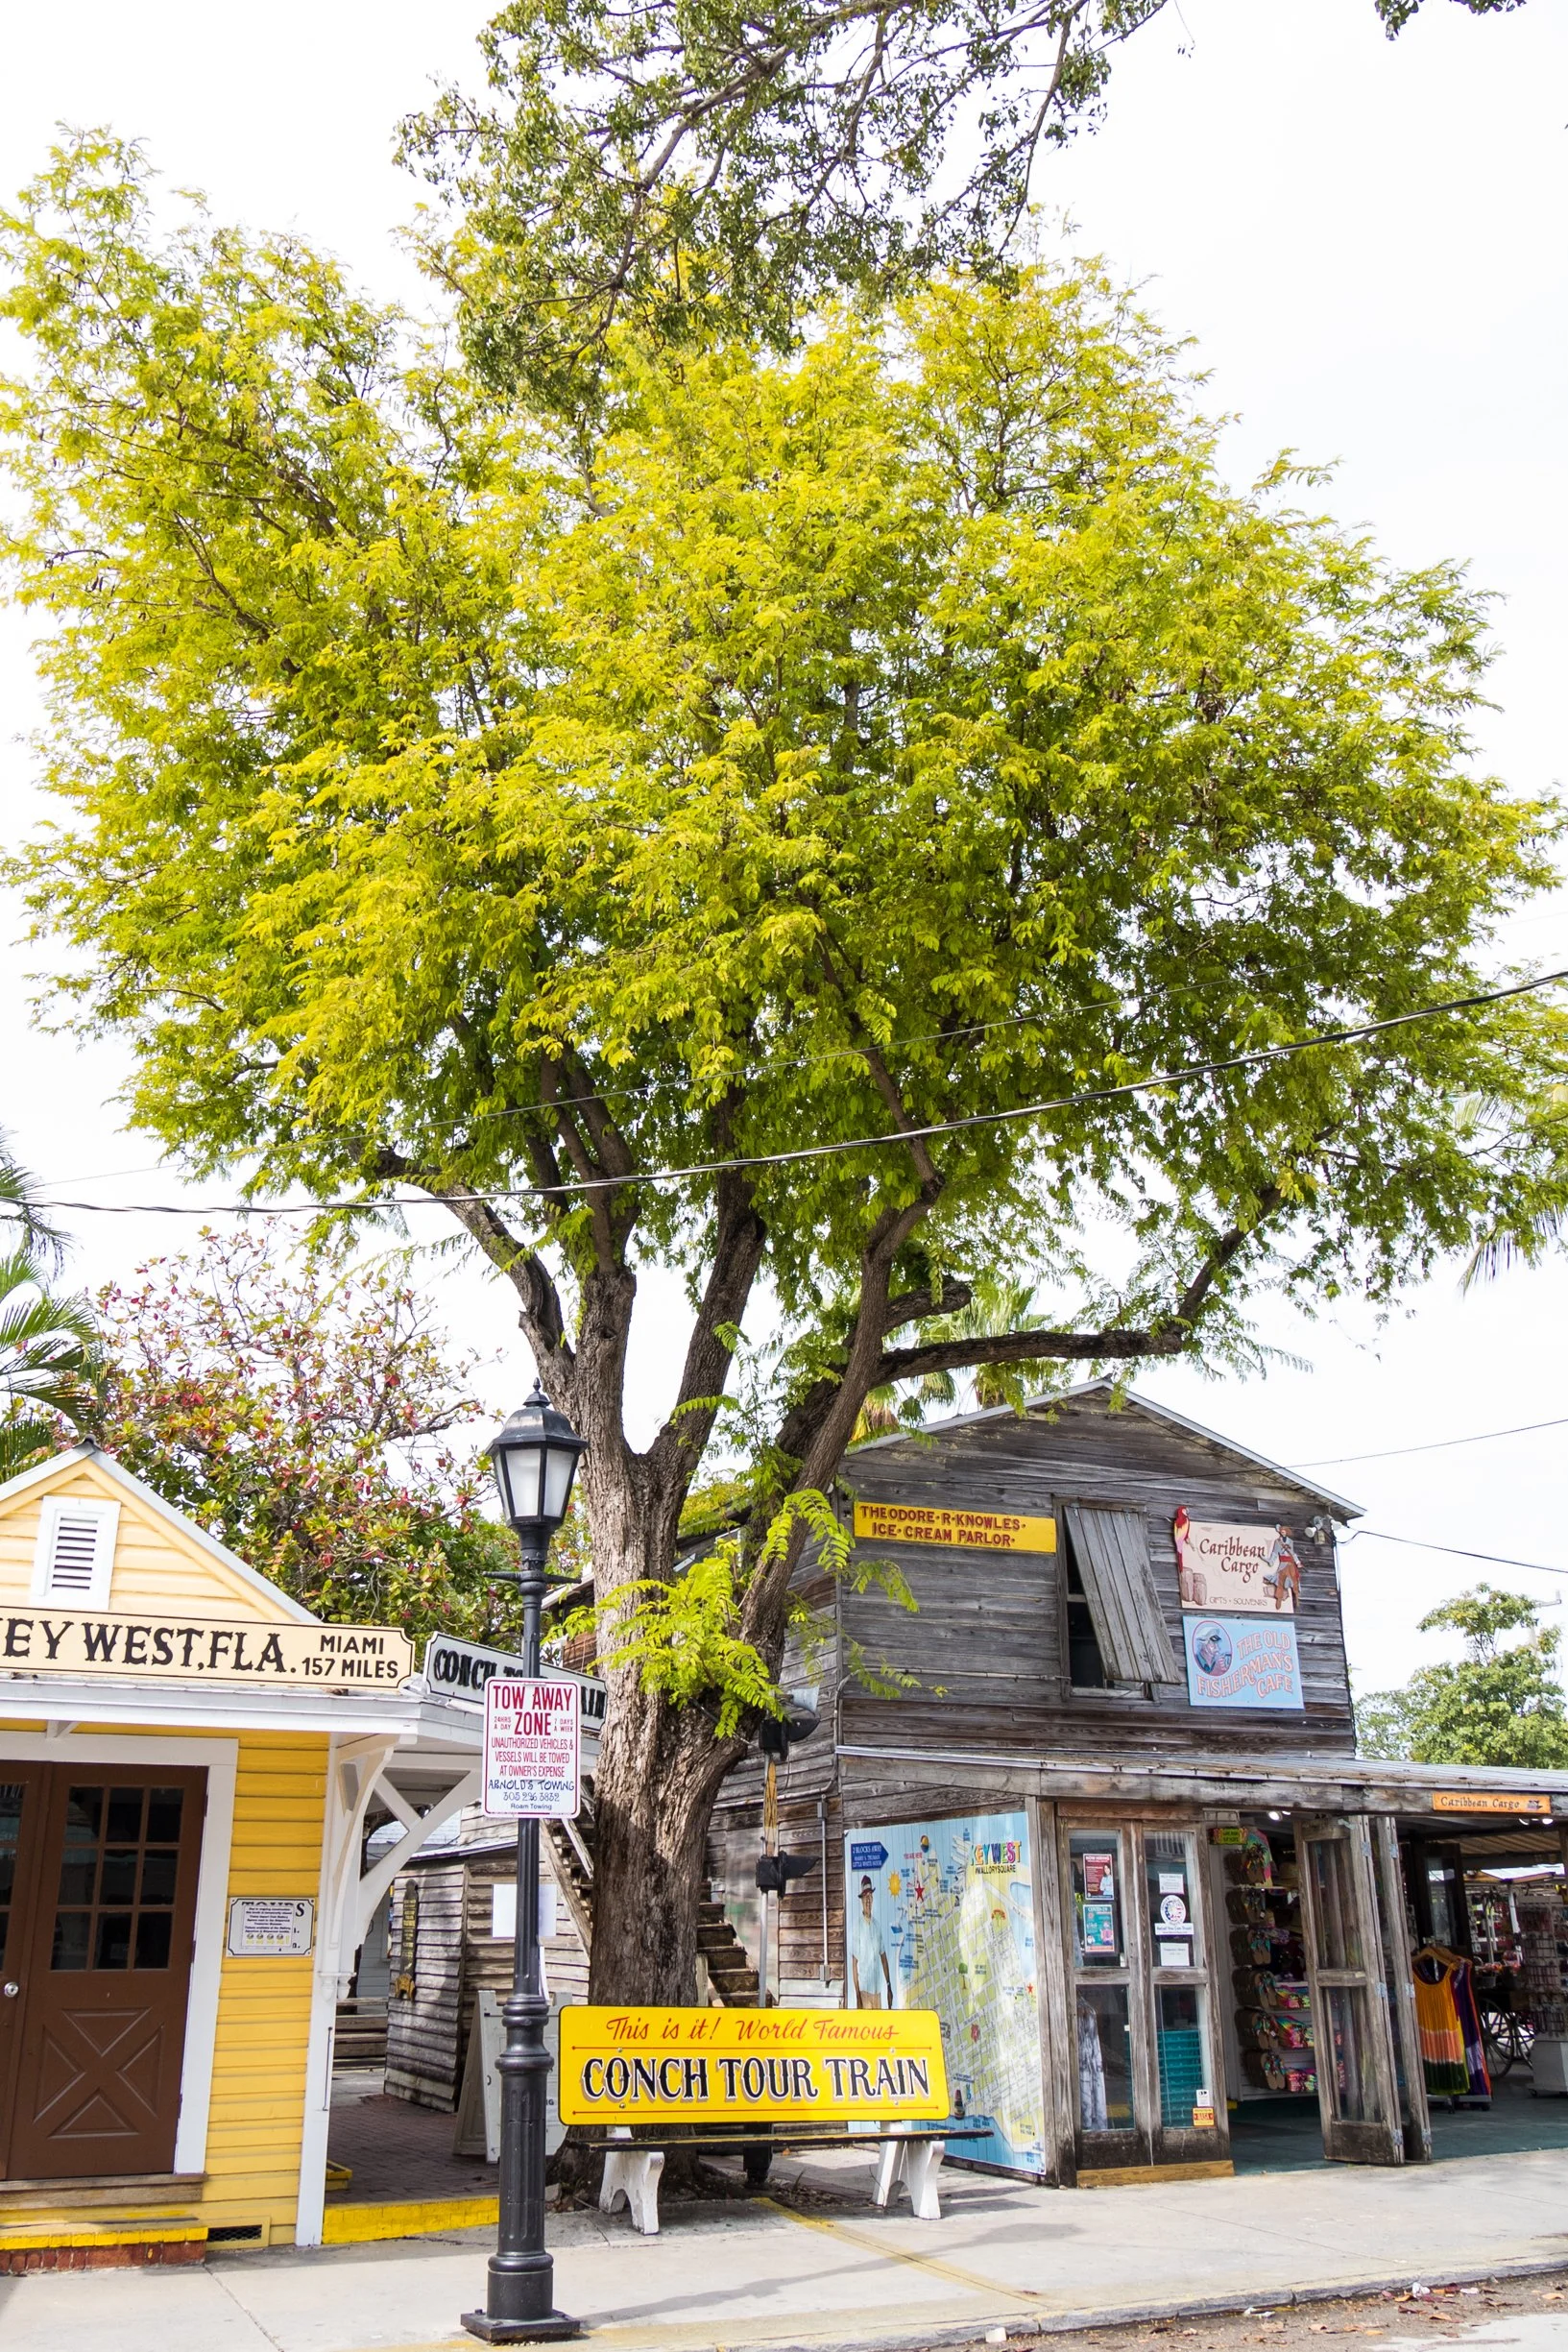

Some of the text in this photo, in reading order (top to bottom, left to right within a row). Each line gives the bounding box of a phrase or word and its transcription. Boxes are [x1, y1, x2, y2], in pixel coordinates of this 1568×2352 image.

[1199, 1537, 1266, 1559] Caribbean
[1220, 1556, 1259, 1584] Cargo
[1209, 1596, 1227, 1605] GIFTS
[0, 1617, 74, 1660] EY
[320, 1634, 383, 1655] MIAMI
[1237, 1629, 1291, 1660] THE OLD
[302, 1657, 398, 1679] 157 MILES
[1196, 1651, 1293, 1698] FISHERMAN'S
[1257, 1673, 1294, 1699] CAFE
[493, 1685, 573, 1711] TOW AWAY
[514, 1711, 551, 1736] ZONE
[491, 1736, 538, 1749] UNAUTHORIZED
[540, 1738, 567, 1750] VEHICLES
[495, 1751, 570, 1764] VESSELS WILL BE TOWED
[499, 1765, 566, 1777] AT OWNER'S EXPENSE
[537, 1779, 575, 1791] TOWING
[503, 1791, 520, 1802] 305
[530, 1803, 552, 1811] Towing
[1440, 1796, 1520, 1811] Caribbean Cargo
[990, 1841, 1022, 1864] WEST
[606, 2016, 900, 2041] This is it! World Famous
[580, 2056, 931, 2100] CONCH TOUR TRAIN
